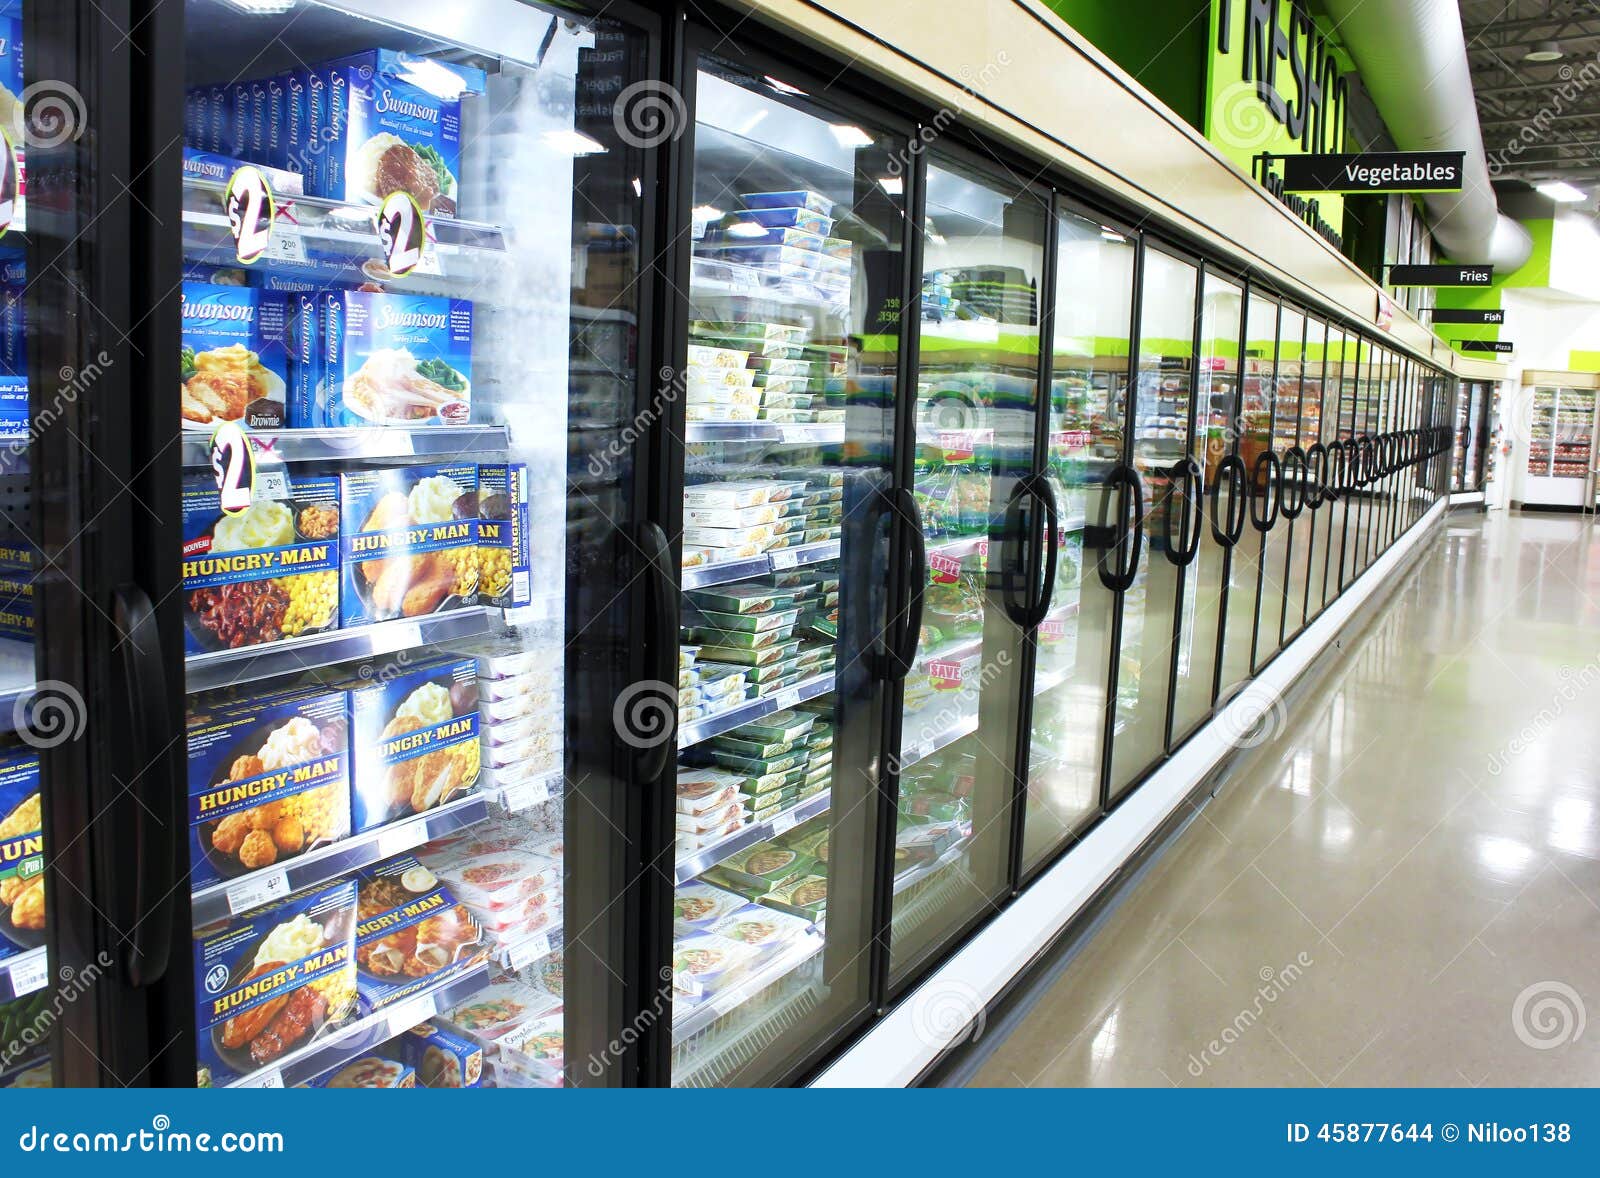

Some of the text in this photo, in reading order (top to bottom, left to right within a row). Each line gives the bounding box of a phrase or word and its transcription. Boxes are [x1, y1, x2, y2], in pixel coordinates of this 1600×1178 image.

[269, 81, 282, 148] Swanson
[289, 77, 304, 146] Swanson
[309, 74, 323, 146] Swanson
[331, 71, 345, 142] Swanson
[376, 89, 438, 124] Swanson
[184, 159, 225, 179] wanson
[1345, 163, 1456, 186] Vegetables
[228, 168, 271, 259] $2
[380, 194, 420, 273] $2
[2, 263, 26, 281] Swan
[270, 276, 314, 292] Swanson
[1460, 271, 1488, 281] Fries
[181, 295, 254, 322] wanson
[376, 305, 447, 331] Swanson
[1484, 313, 1502, 321] Fish
[301, 295, 314, 365] Swanson
[328, 294, 341, 365] Swanson
[250, 413, 280, 426] Brownie
[212, 424, 251, 510] $2
[511, 471, 520, 567] HUNGRY-MAN
[183, 539, 209, 554] NOUVEAU
[352, 524, 470, 552] HUNGRY-MAN
[182, 546, 328, 578] HUNGRY-MAN
[931, 555, 960, 577] SAVE
[1039, 622, 1064, 634] SAVE
[930, 665, 960, 680] SAVE
[380, 718, 472, 756] UNGRY-MAN
[200, 758, 341, 811] HUNGRY-MAN
[196, 808, 224, 820] SATISFY
[226, 803, 243, 811] YOUR
[357, 893, 444, 937] NGRY-MAN
[214, 947, 349, 1014] HUNGRY-MAN
